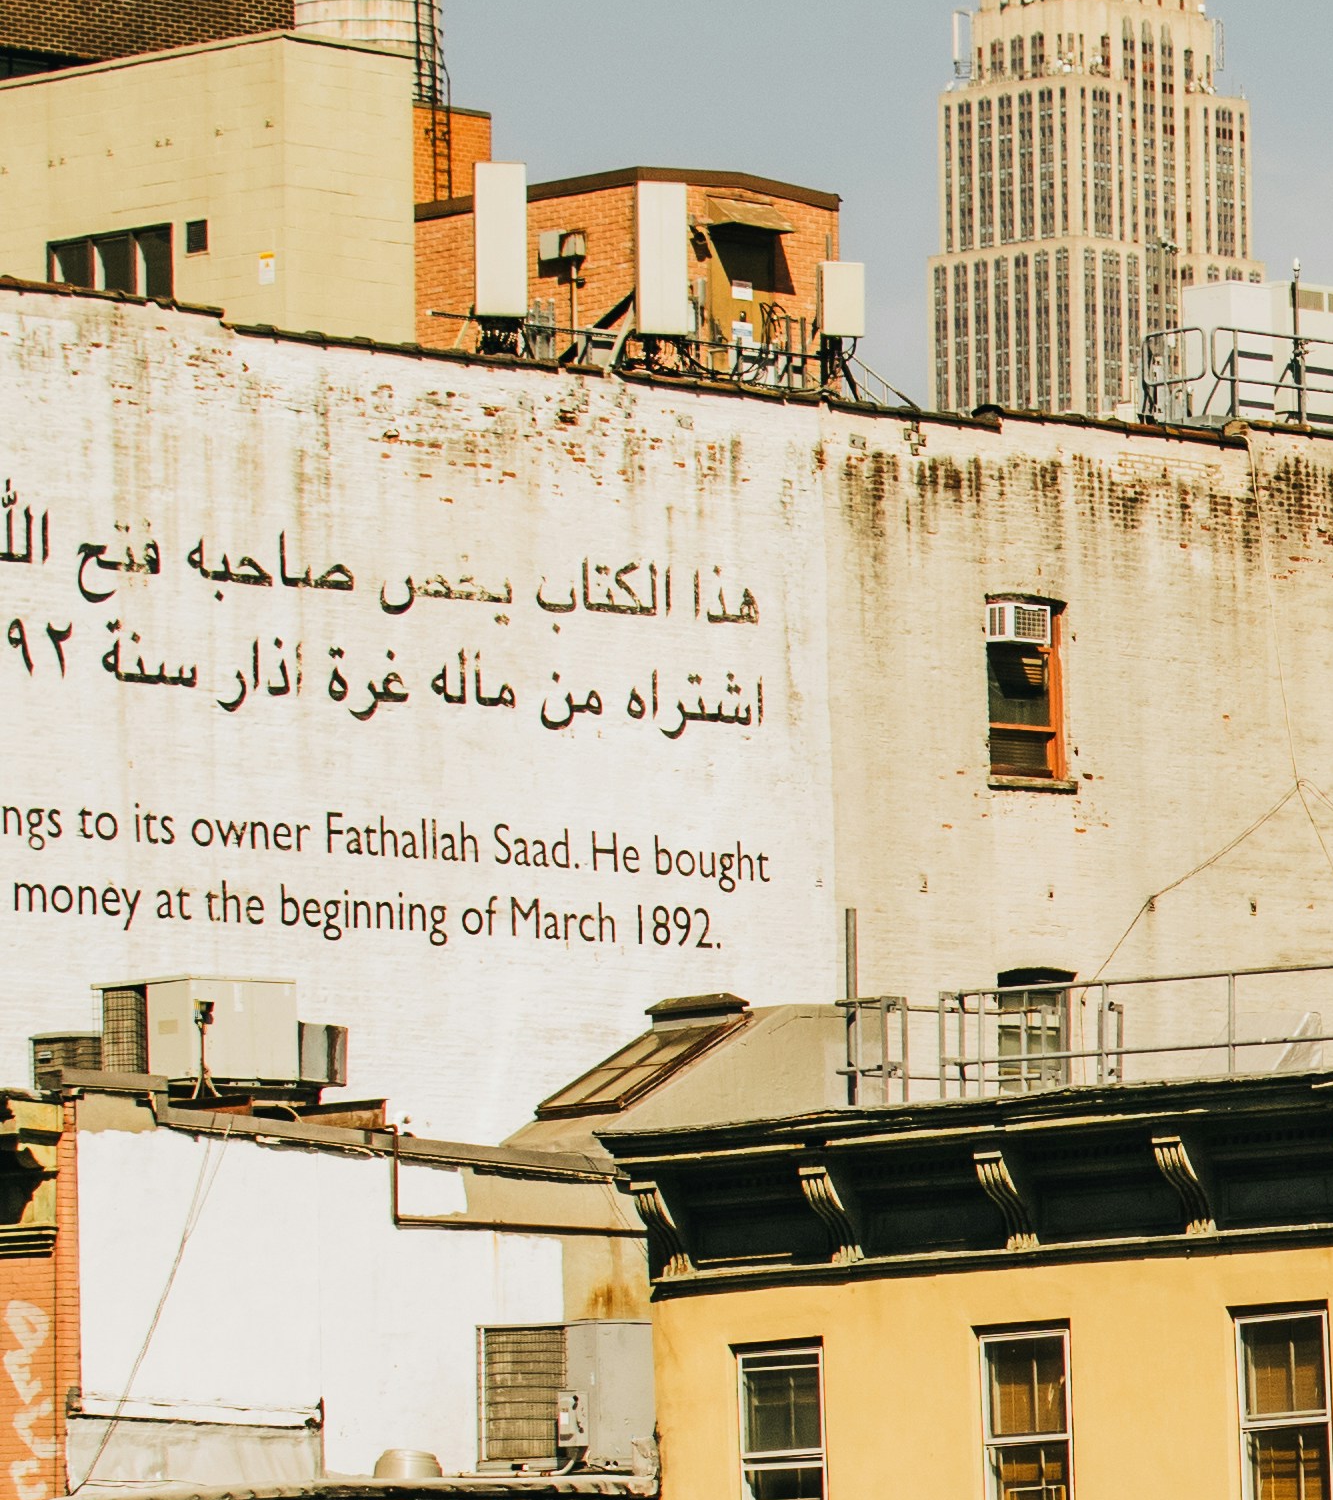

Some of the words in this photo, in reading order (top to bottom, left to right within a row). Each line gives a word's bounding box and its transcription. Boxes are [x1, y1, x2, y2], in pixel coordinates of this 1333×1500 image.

[77, 519, 161, 603] فتح
[187, 530, 355, 601] صاحبه
[380, 554, 513, 627] يخص
[536, 555, 673, 634] الكتاب
[694, 564, 760, 626] هذا
[101, 618, 198, 688] سنة
[215, 636, 303, 712] اذار
[328, 646, 410, 721] غرة
[431, 647, 517, 709] ماله
[540, 671, 603, 730] من
[626, 668, 764, 740] اشتراه
[77, 805, 119, 841] to
[134, 802, 175, 845] its
[191, 817, 311, 852] owner
[326, 810, 479, 863] Fathallah
[493, 823, 581, 870] Saad.
[591, 830, 641, 874] He
[654, 833, 771, 894] bought
[13, 881, 142, 931] money
[156, 886, 192, 921] at
[204, 879, 265, 925] the
[279, 882, 448, 947] beginning
[461, 894, 499, 937] of
[510, 895, 616, 943] March
[637, 903, 721, 950] 1892.
